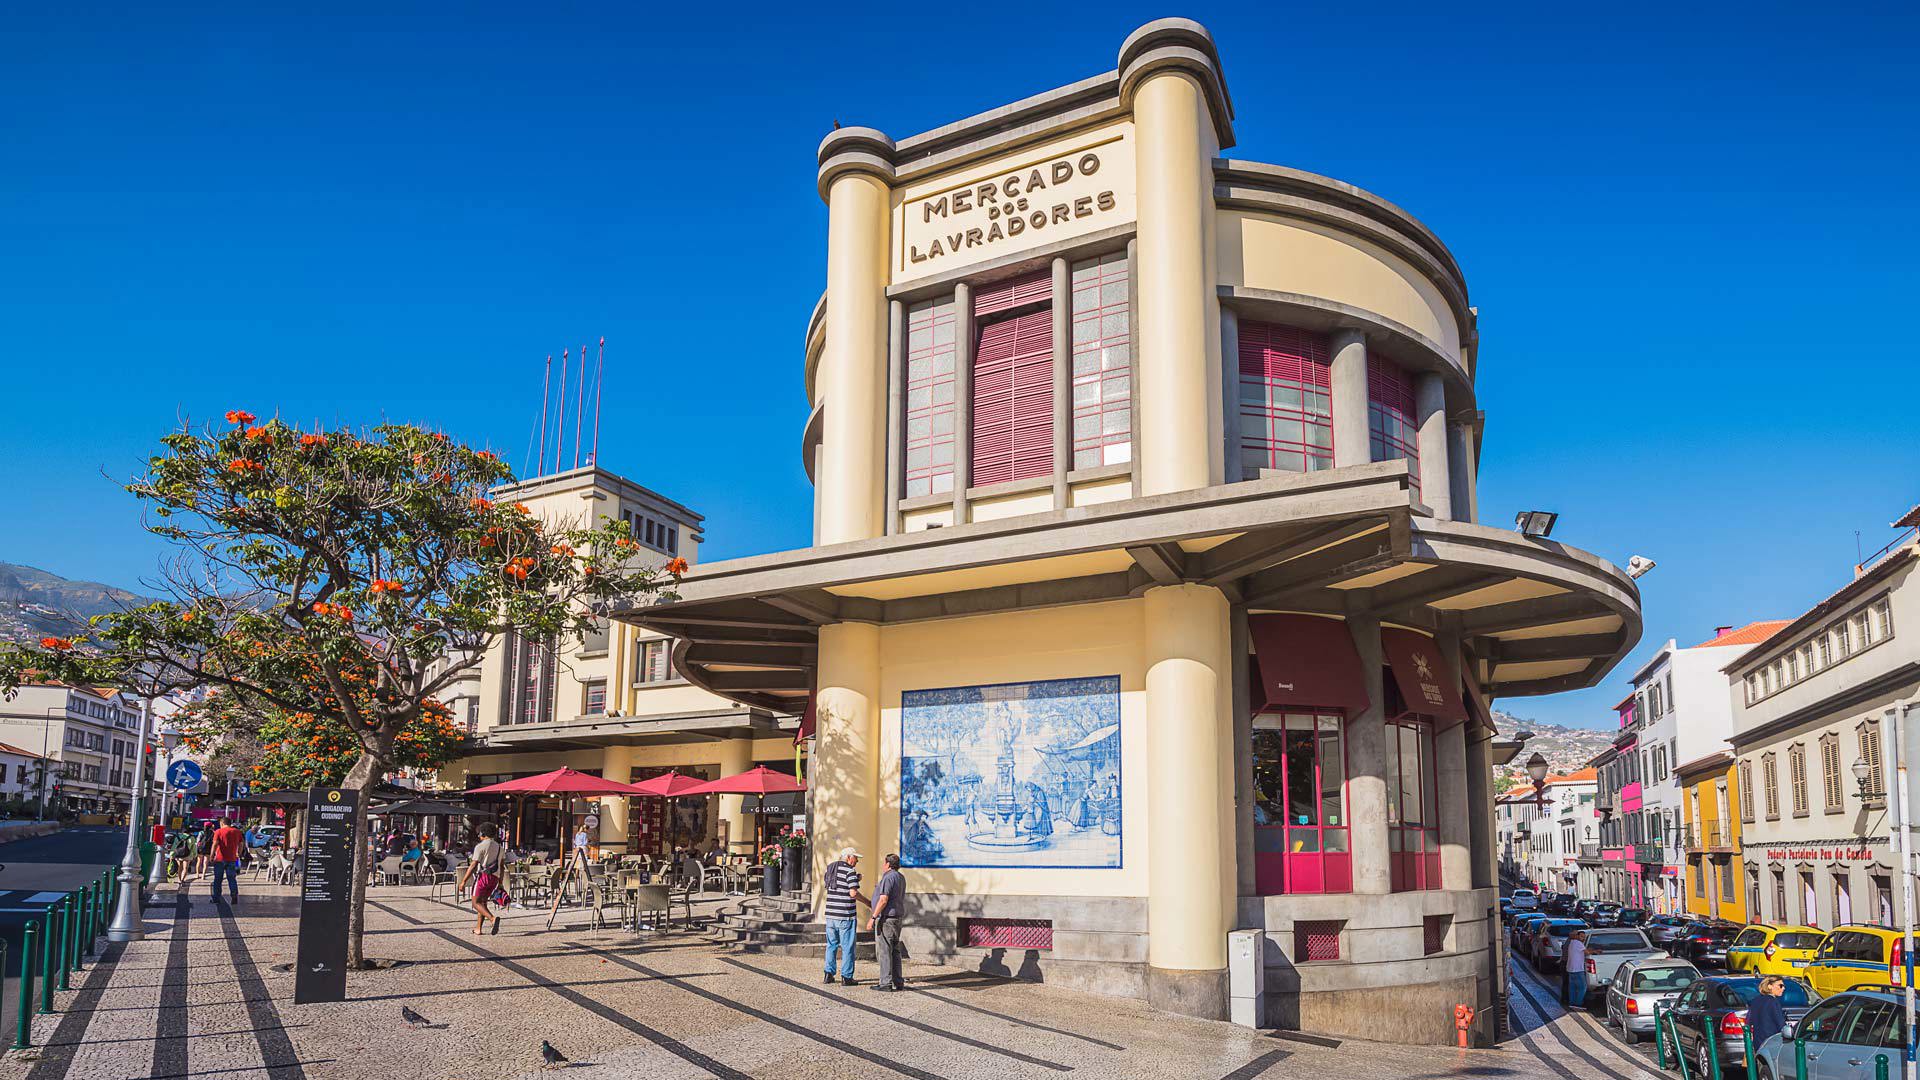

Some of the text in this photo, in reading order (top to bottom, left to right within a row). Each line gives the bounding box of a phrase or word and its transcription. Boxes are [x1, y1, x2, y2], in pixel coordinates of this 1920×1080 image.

[923, 153, 1100, 223] MERCADO
[988, 197, 1029, 220] DOS
[911, 190, 1116, 263] LAVRADORES
[1835, 847, 1843, 860] de
